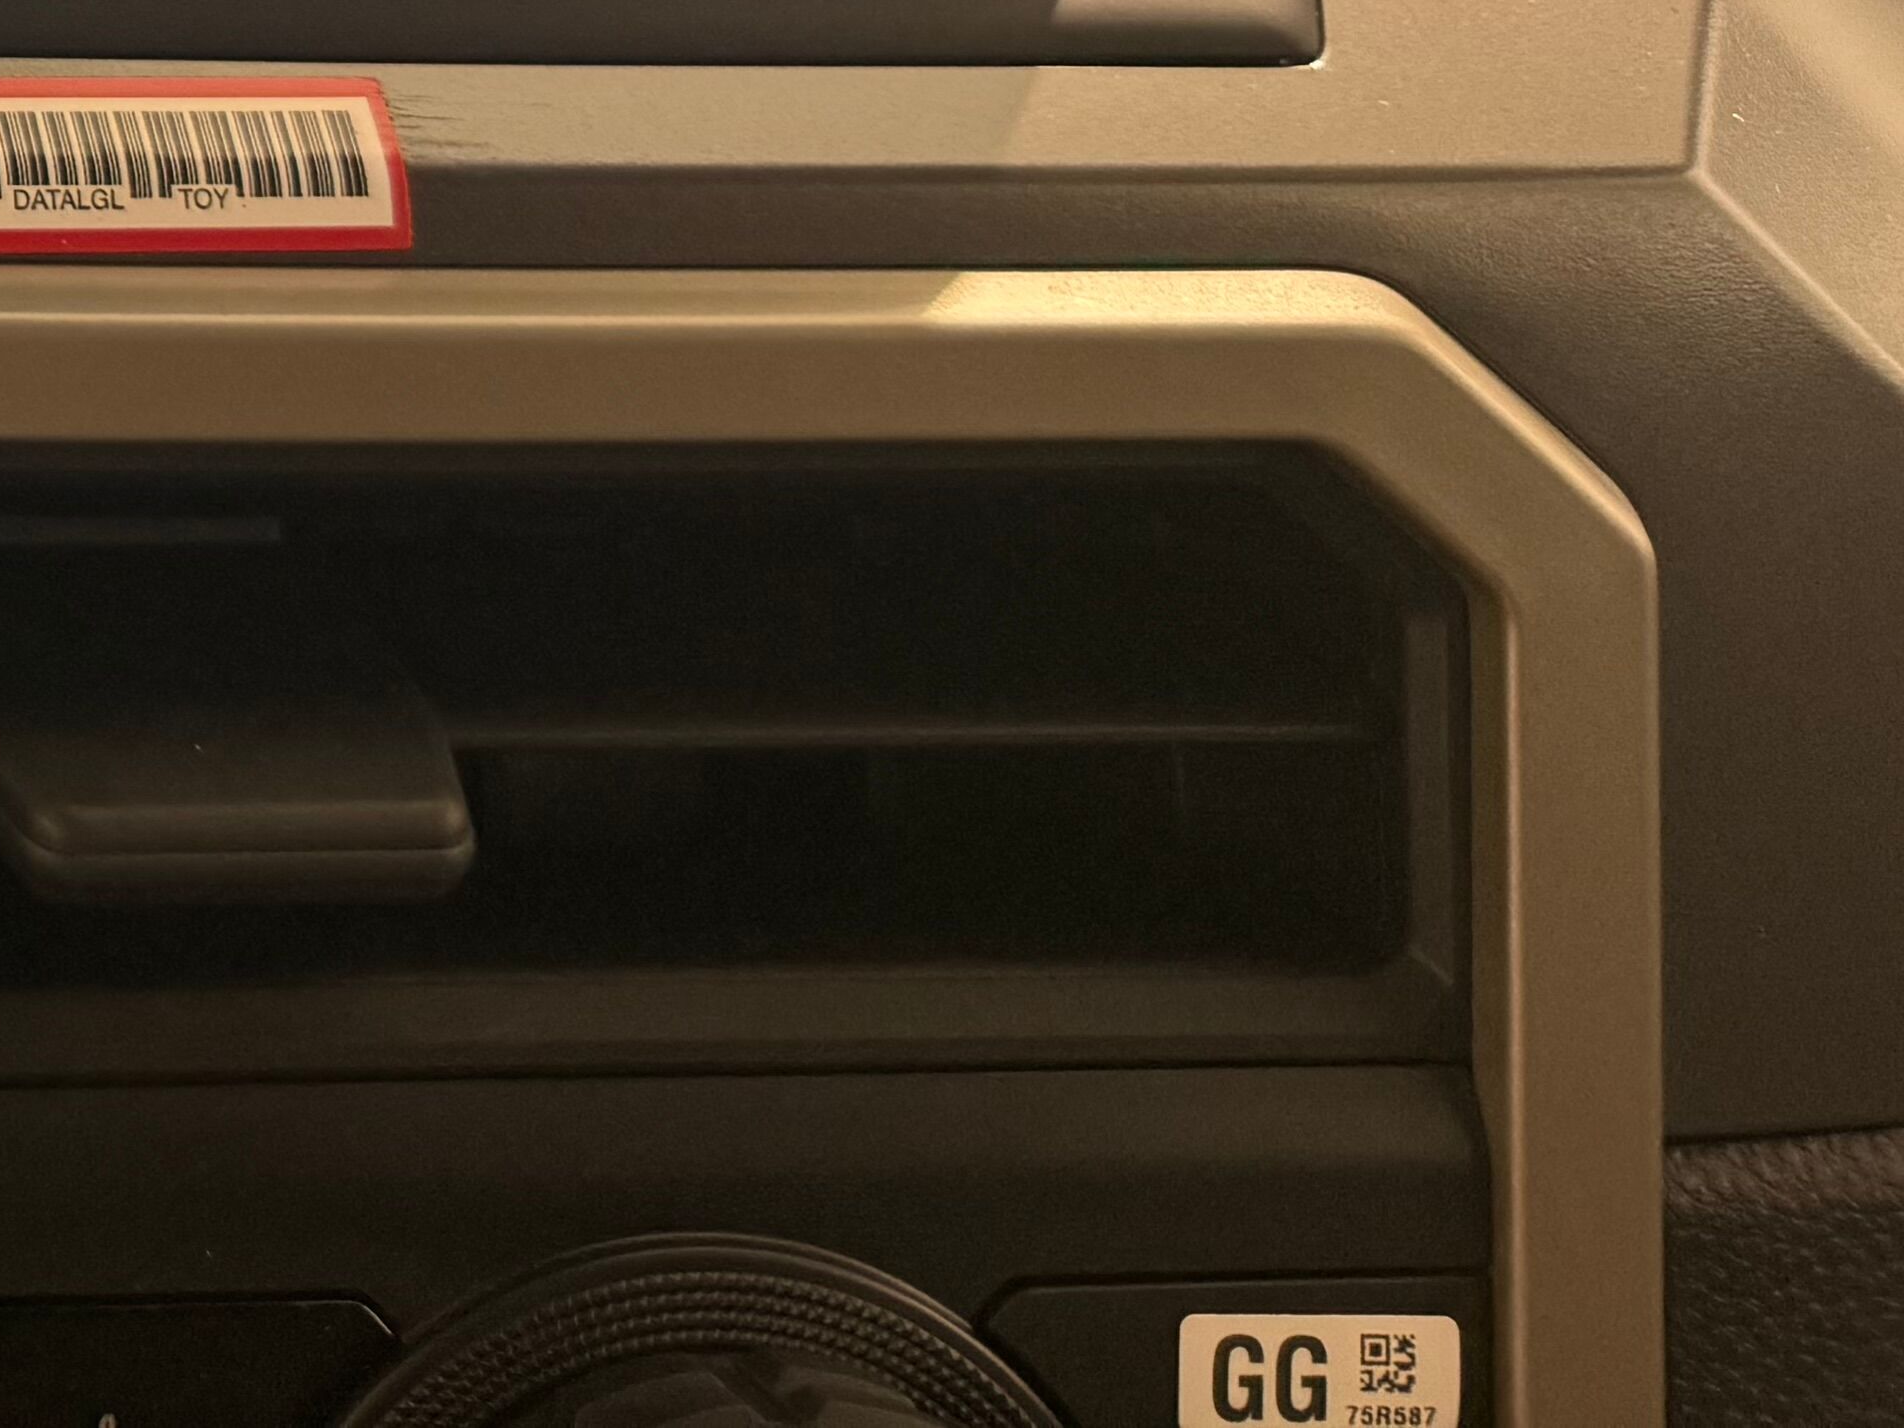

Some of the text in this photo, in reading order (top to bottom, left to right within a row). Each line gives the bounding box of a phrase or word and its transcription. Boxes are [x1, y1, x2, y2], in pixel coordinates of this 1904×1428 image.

[12, 188, 125, 211] DATALGL
[178, 187, 230, 210] TOY
[1212, 1333, 1328, 1423] GG
[1345, 1405, 1437, 1426] 75R587
